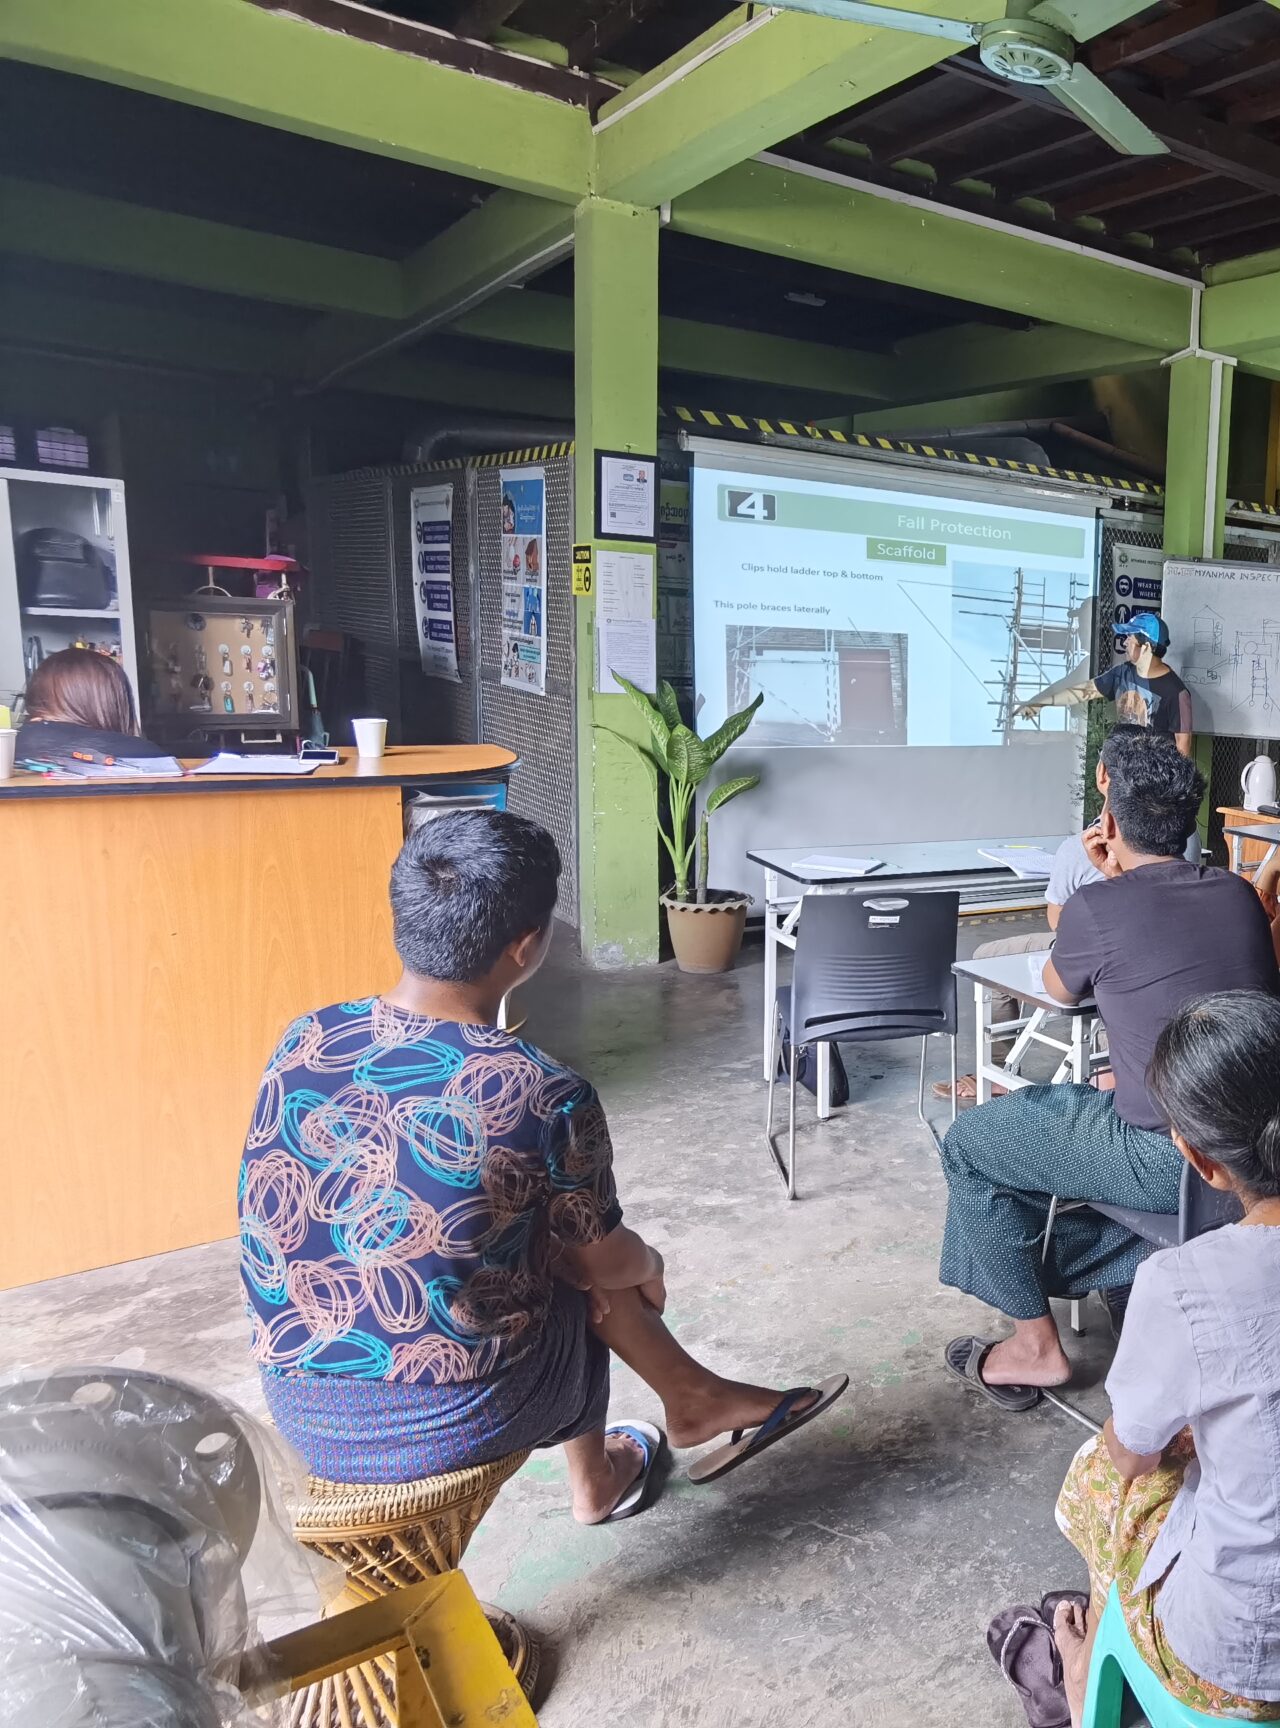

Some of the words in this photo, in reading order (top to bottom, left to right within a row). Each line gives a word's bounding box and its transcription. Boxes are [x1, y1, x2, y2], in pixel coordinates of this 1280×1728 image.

[737, 491, 768, 520] 4
[897, 514, 925, 530] Fall
[930, 518, 1012, 540] Protection
[877, 543, 936, 560] Scaffold
[741, 563, 765, 573] Clips
[766, 564, 788, 574] hold
[790, 566, 820, 576] ladder
[823, 569, 838, 578] top
[841, 570, 849, 578] &
[850, 572, 884, 581] bottom
[1194, 569, 1236, 579] MYANMAR
[713, 600, 734, 610] This
[736, 602, 758, 611] pole
[760, 602, 791, 612] braces
[794, 604, 831, 615] laterally
